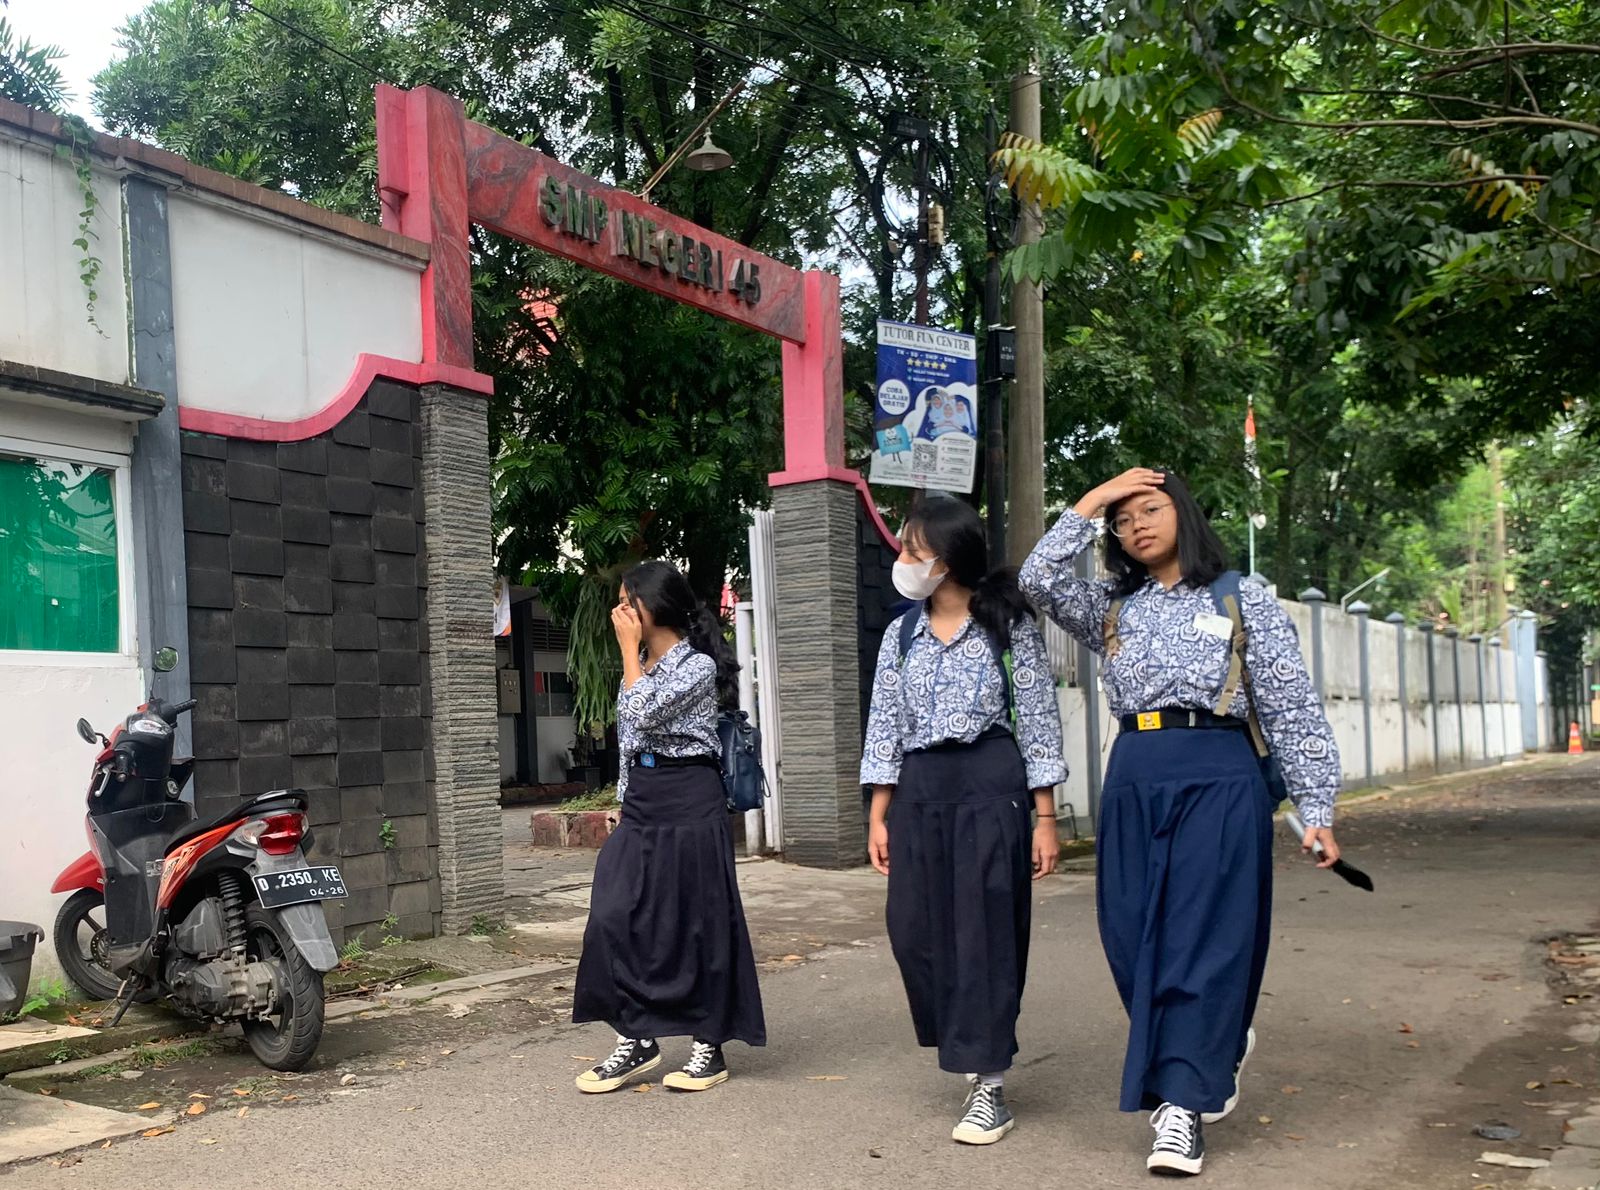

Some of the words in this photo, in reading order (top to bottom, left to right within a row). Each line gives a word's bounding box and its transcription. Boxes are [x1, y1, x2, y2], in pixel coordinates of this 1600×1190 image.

[540, 175, 608, 243] SMP
[612, 209, 723, 293] NEGERI
[729, 258, 761, 304] 45
[883, 325, 914, 342] TUTOR
[916, 331, 934, 345] FUN
[936, 335, 970, 351] CENTER
[257, 878, 269, 891] D
[278, 871, 313, 888] 2350
[321, 868, 341, 882] KE
